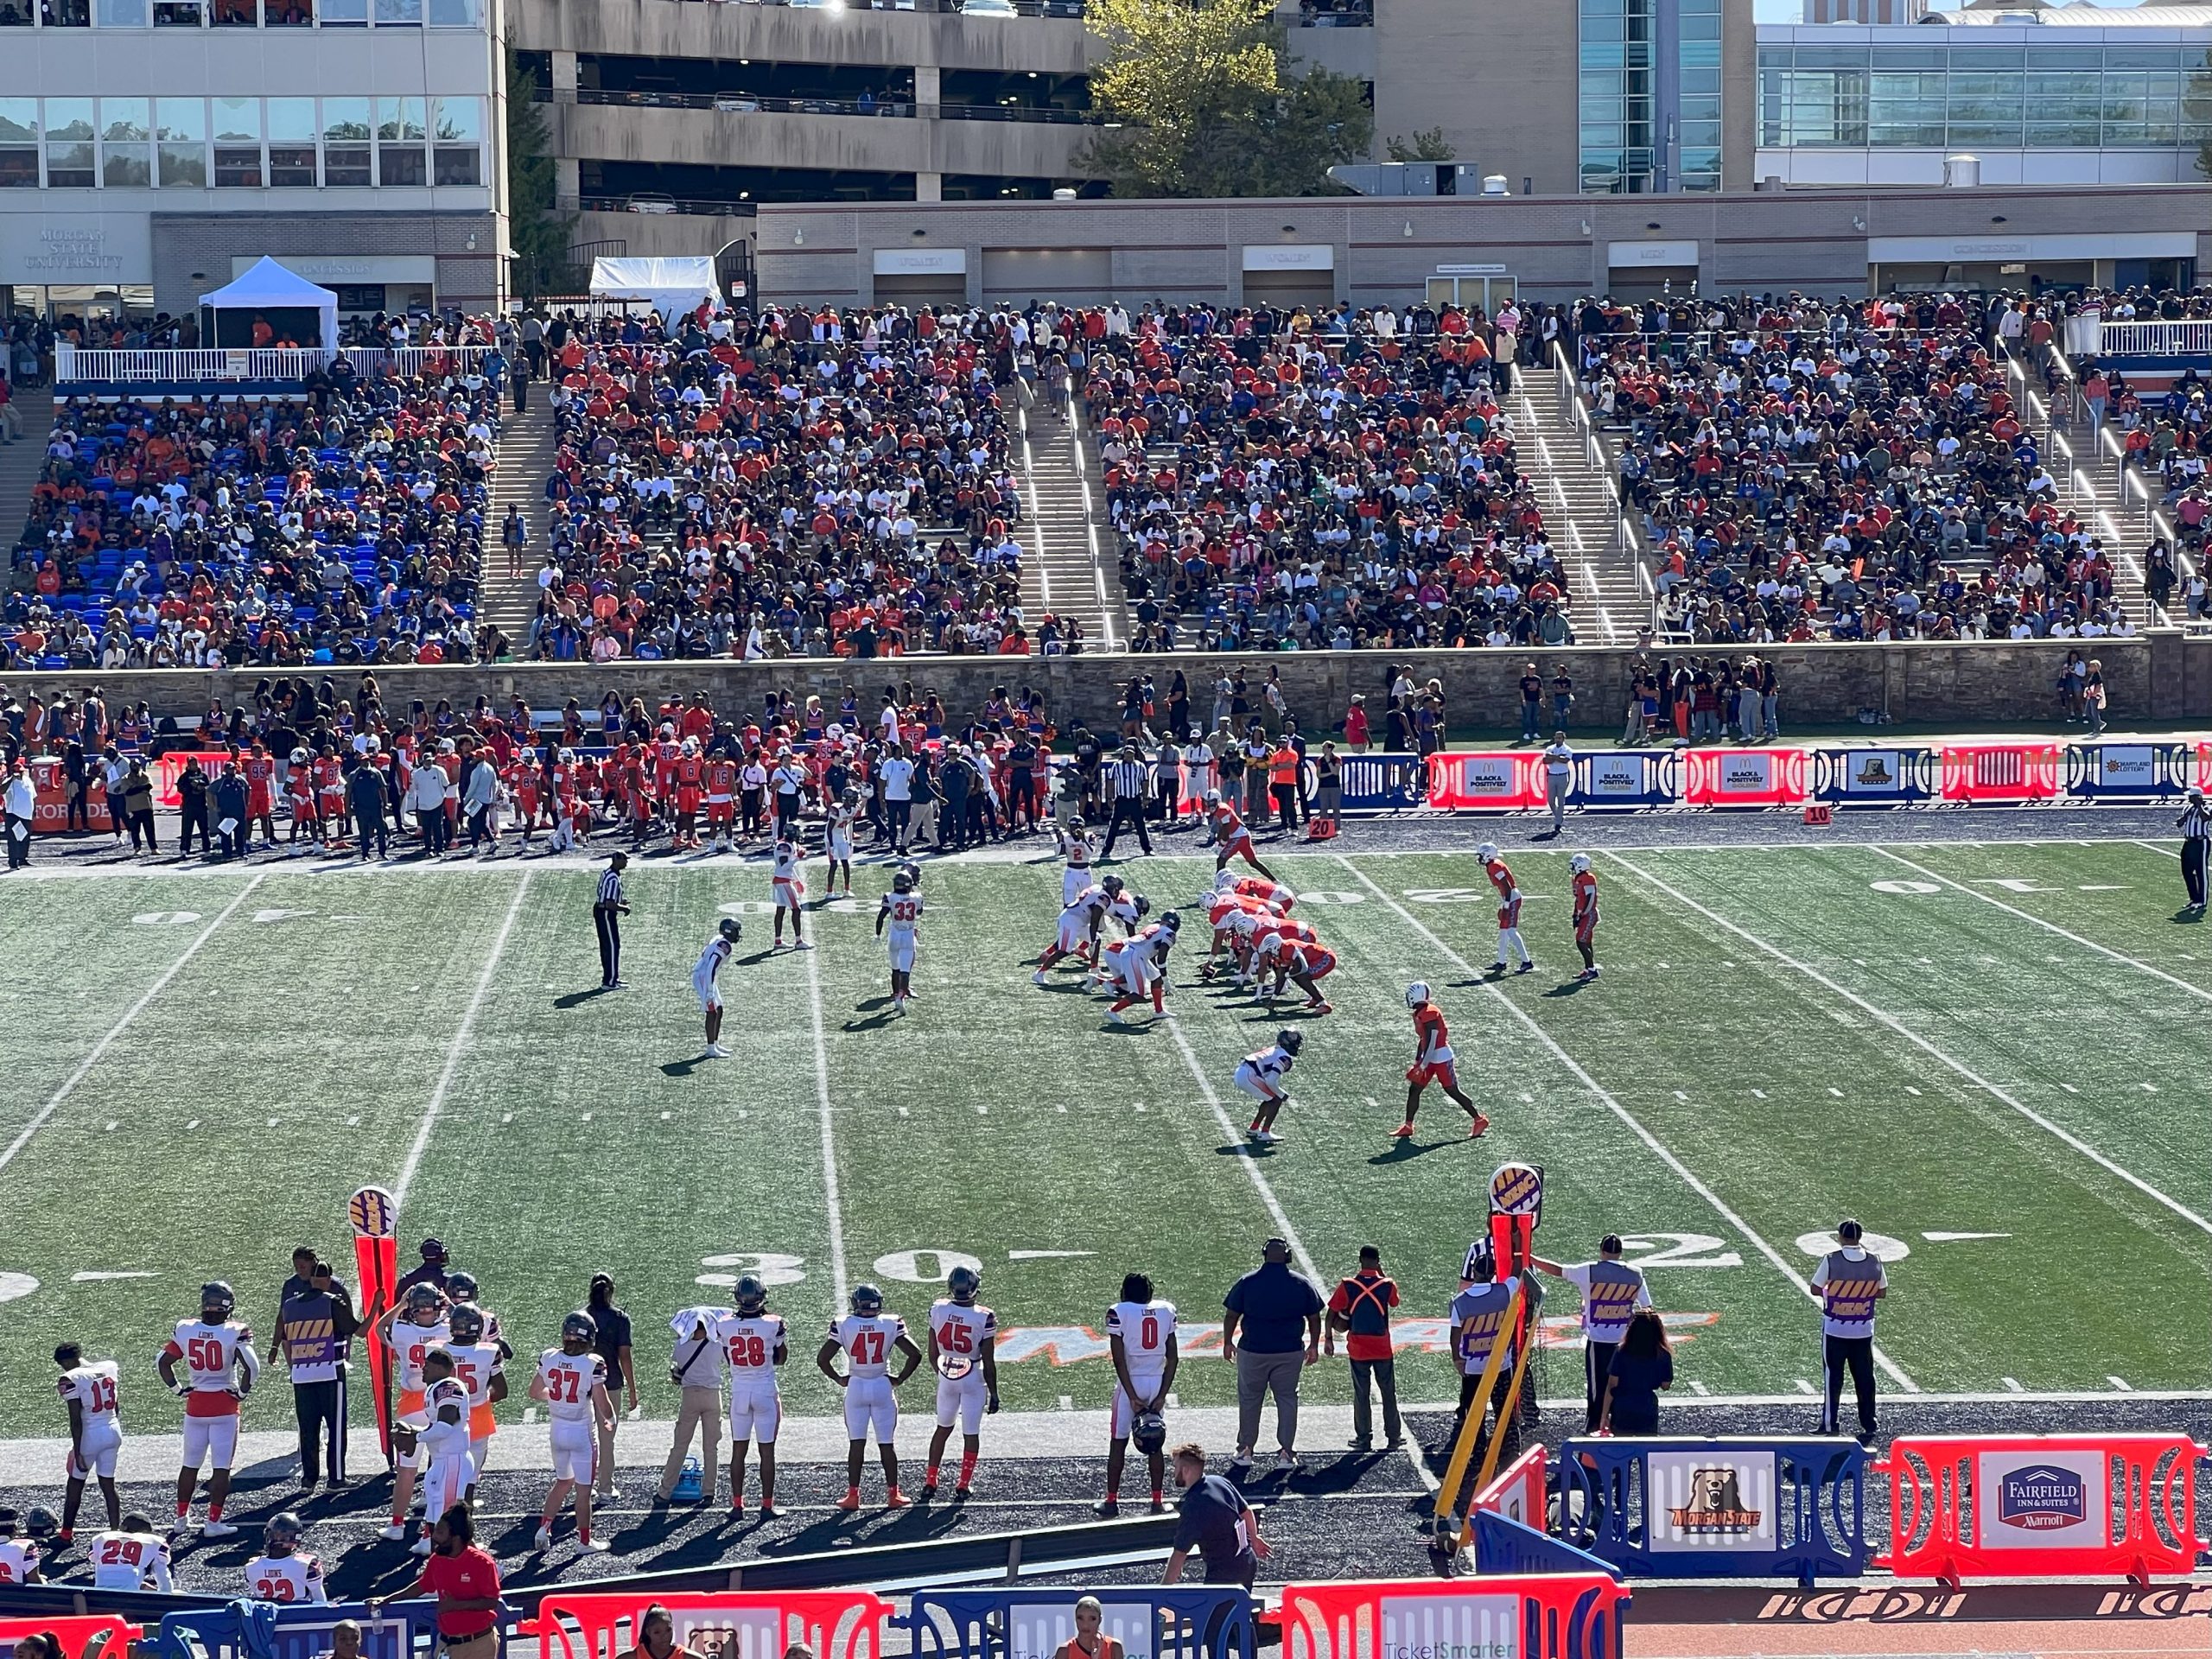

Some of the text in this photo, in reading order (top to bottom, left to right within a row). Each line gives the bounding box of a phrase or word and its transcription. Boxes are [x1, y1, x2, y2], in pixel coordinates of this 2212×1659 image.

[41, 229, 105, 241] MORGAN
[50, 243, 98, 255] STATE
[24, 256, 122, 269] UNIVERSITY
[661, 745, 675, 760] 42
[38, 767, 48, 778] G
[251, 766, 266, 779] 95
[715, 770, 728, 785] 16
[1810, 808, 1827, 821] 10
[1312, 821, 1329, 835] 20
[1073, 849, 1083, 861] 2
[894, 902, 915, 921] 33
[1593, 1303, 1631, 1319] MEAC
[1832, 1300, 1871, 1316] MEAC
[948, 1314, 963, 1324] LIONS
[198, 1331, 214, 1339] LIONS
[938, 1322, 973, 1354] 45
[1141, 1317, 1159, 1350] 0
[188, 1339, 223, 1371] 50
[729, 1336, 766, 1367] 28
[851, 1332, 885, 1364] 47
[558, 1361, 572, 1370] LIONS
[548, 1369, 580, 1403] 37
[91, 1376, 117, 1414] 13
[2009, 1482, 2077, 1499] FAIRFIELD
[2023, 1515, 2063, 1528] Marriott
[101, 1540, 143, 1566] 29
[264, 1569, 282, 1578] LIONS
[1384, 1641, 1517, 1659] TicketSmarter
